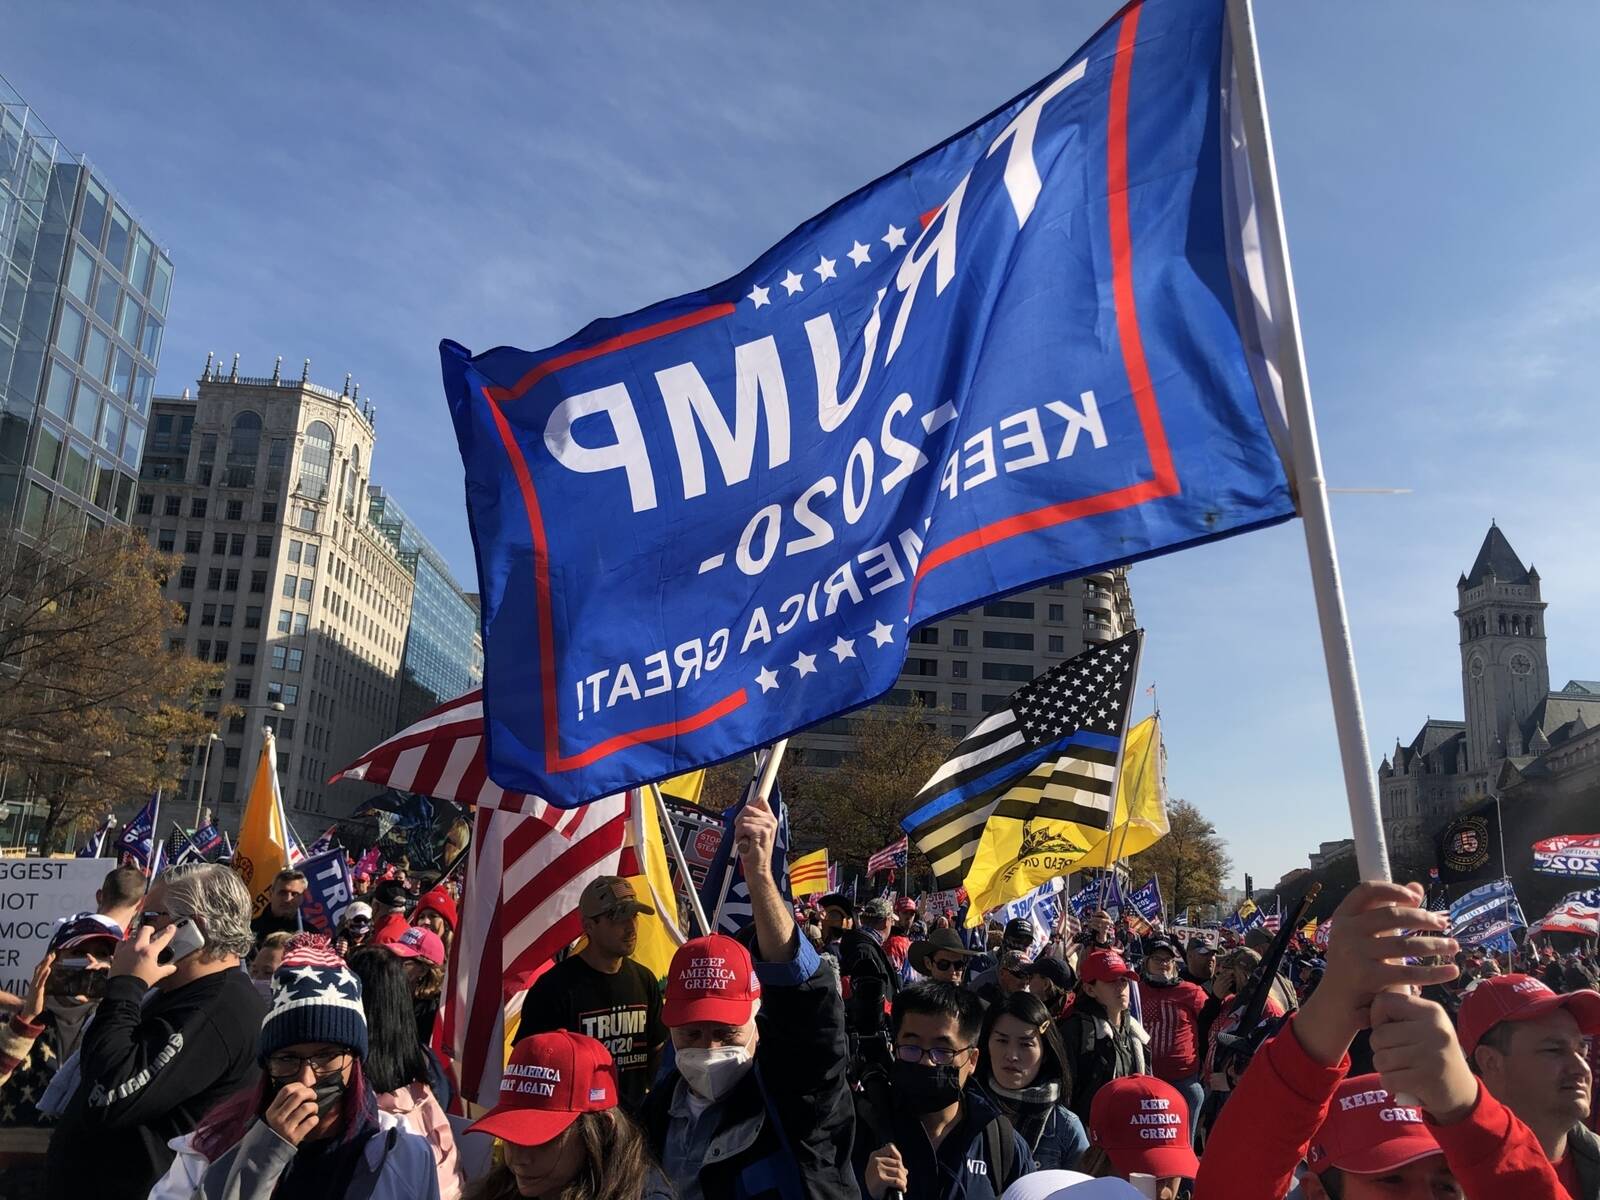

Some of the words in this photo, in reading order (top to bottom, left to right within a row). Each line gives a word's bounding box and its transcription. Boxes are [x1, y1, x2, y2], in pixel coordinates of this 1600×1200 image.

[699, 832, 722, 845] STOP
[0, 863, 68, 880] GGEST
[316, 858, 348, 927] TRU
[928, 892, 947, 902] STOP
[0, 893, 39, 910] IOT
[932, 899, 955, 909] STEAL
[0, 921, 54, 940] MOC
[0, 949, 20, 967] ER
[691, 957, 726, 968] KEEP
[679, 967, 737, 981] AMERICA
[684, 979, 729, 990] GREAT
[582, 1009, 647, 1039] TRUMP
[603, 1036, 634, 1055] 2020
[512, 1064, 561, 1082] AMERICA
[516, 1081, 556, 1098] AGAIN
[1140, 1099, 1170, 1110] KEEP
[1339, 1089, 1388, 1111] KEEP
[1129, 1113, 1181, 1125] AMERICA
[1379, 1107, 1424, 1122] GRE
[1140, 1127, 1178, 1139] GREAT
[966, 1157, 988, 1176] NTD
